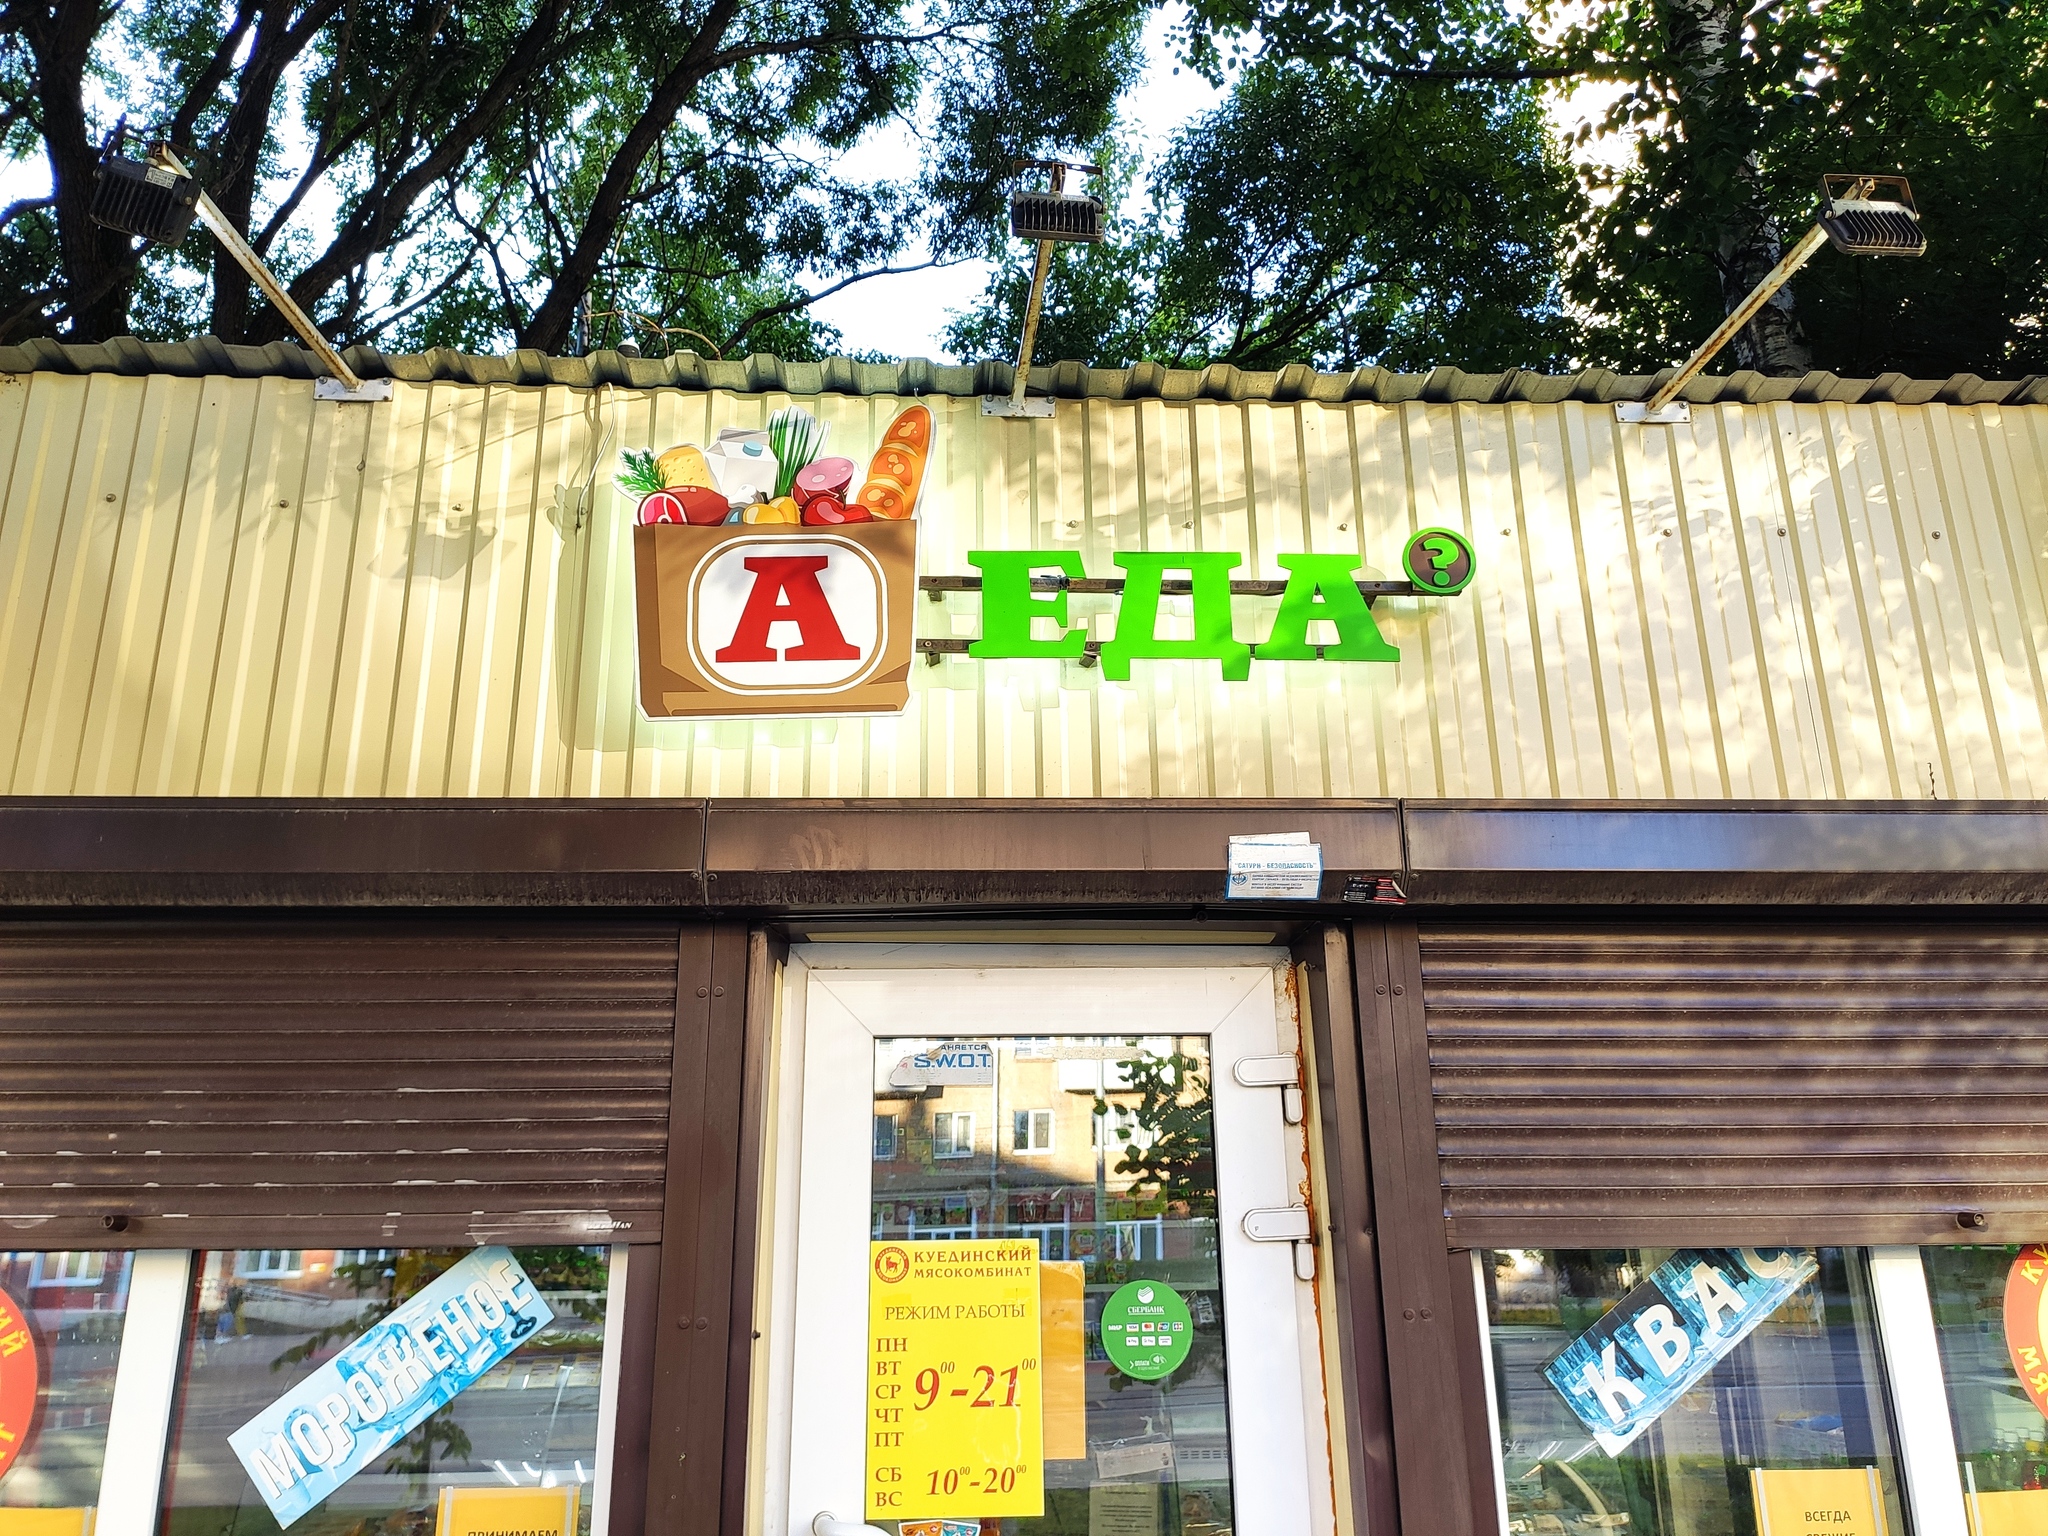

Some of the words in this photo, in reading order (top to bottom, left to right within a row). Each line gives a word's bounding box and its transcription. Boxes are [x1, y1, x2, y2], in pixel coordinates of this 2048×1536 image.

[914, 1246, 1031, 1263] КУЕДИНСКИЙ
[914, 1267, 1031, 1279] МЯСОКОМБИНАТ
[885, 1305, 951, 1320] РЕЖИМ
[955, 1303, 1026, 1319] РАБОТЫ
[876, 1337, 908, 1352] ПН
[876, 1360, 902, 1376] ВТ
[250, 1258, 534, 1500] МОРОЖЕНОЕ
[875, 1384, 902, 1399] СР
[874, 1408, 903, 1423] ЧТ
[874, 1432, 904, 1447] ПТ
[875, 1466, 902, 1483] СБ
[875, 1491, 903, 1507] ВС
[1804, 1510, 1852, 1524] ВСЕГДА
